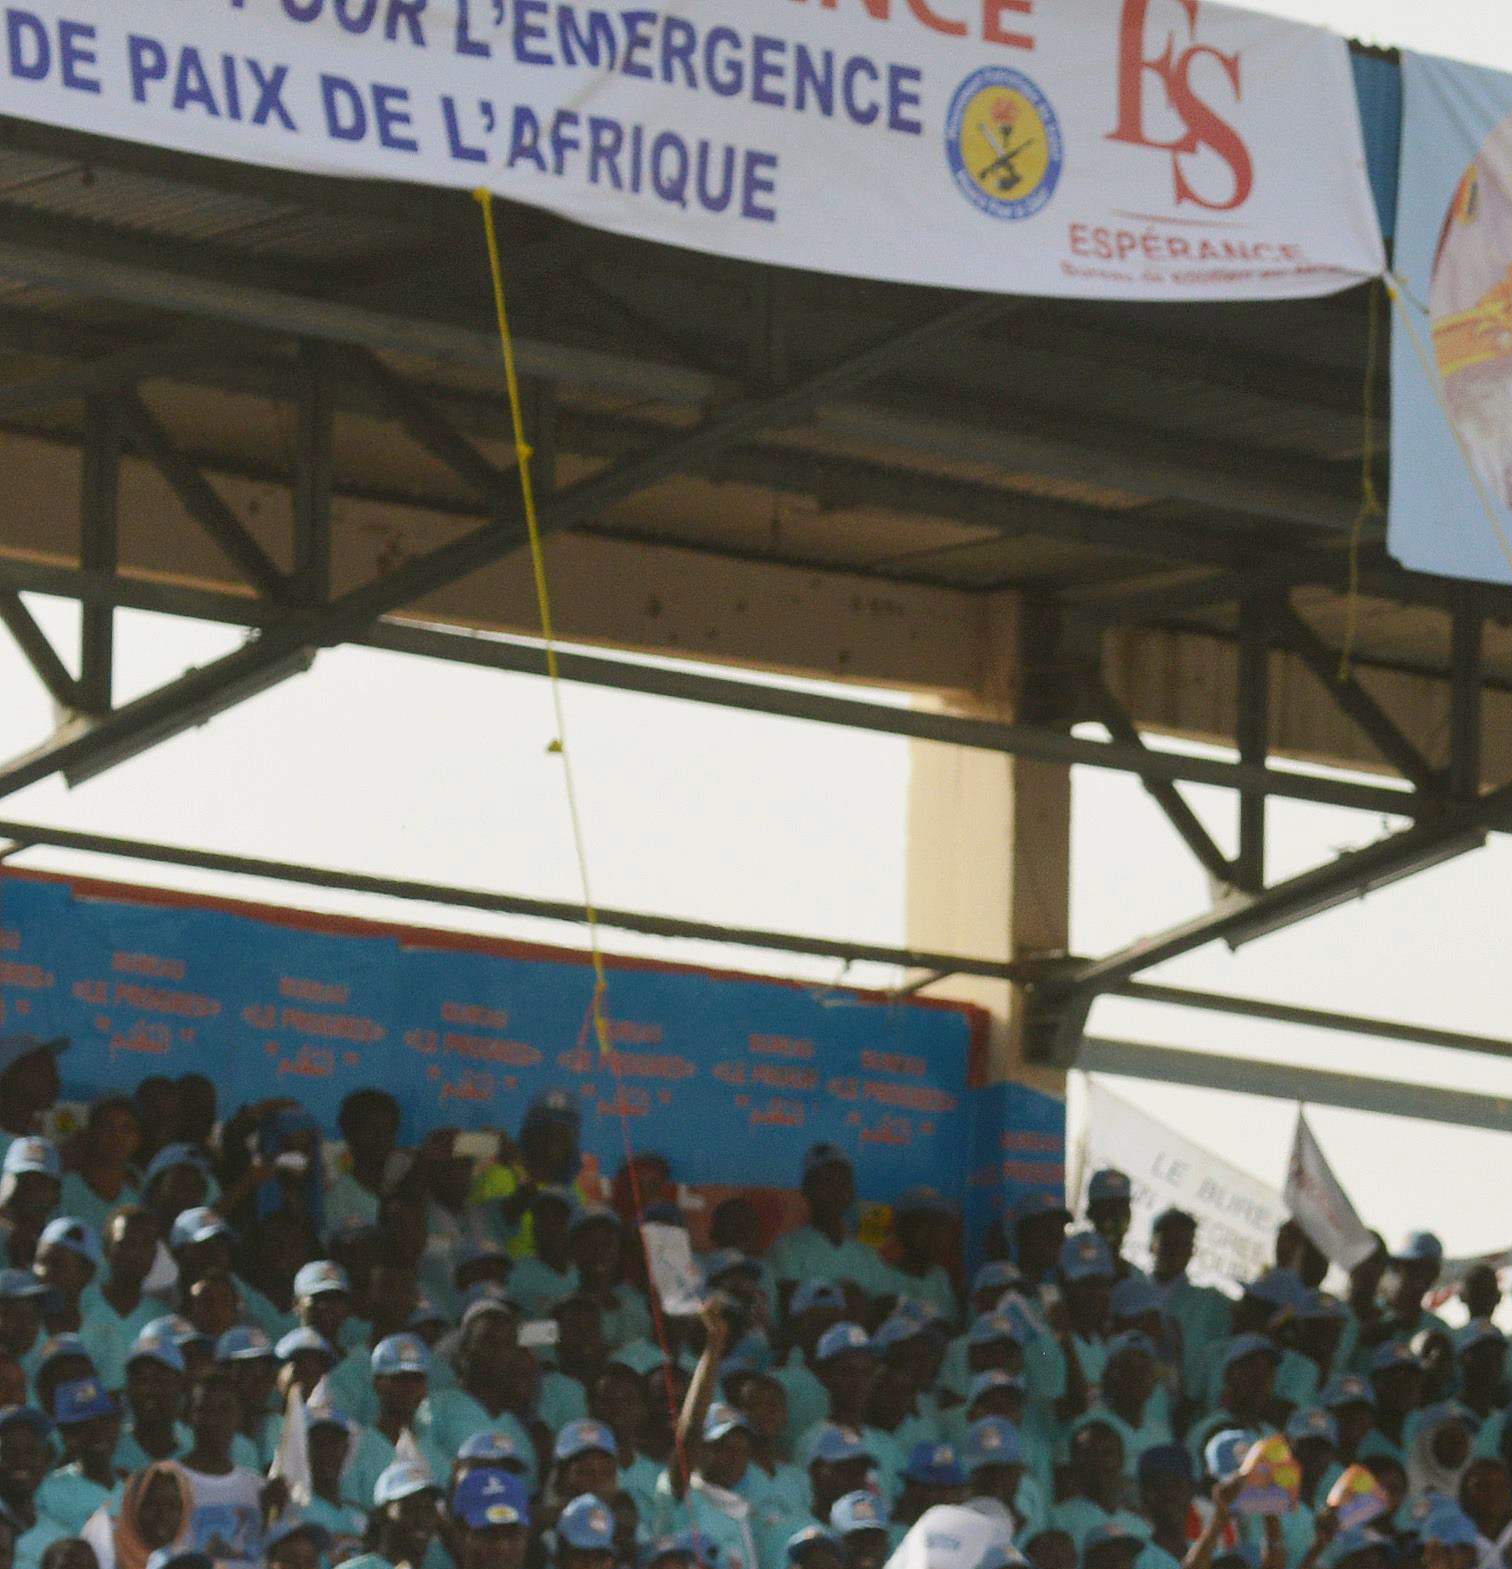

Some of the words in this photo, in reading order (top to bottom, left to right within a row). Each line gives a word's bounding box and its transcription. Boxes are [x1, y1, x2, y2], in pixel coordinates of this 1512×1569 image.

[233, 0, 428, 48] UR
[7, 8, 102, 95] DE
[127, 33, 297, 132] PAIX
[320, 74, 418, 153] DE
[441, 95, 780, 223] L'AFRIQUE
